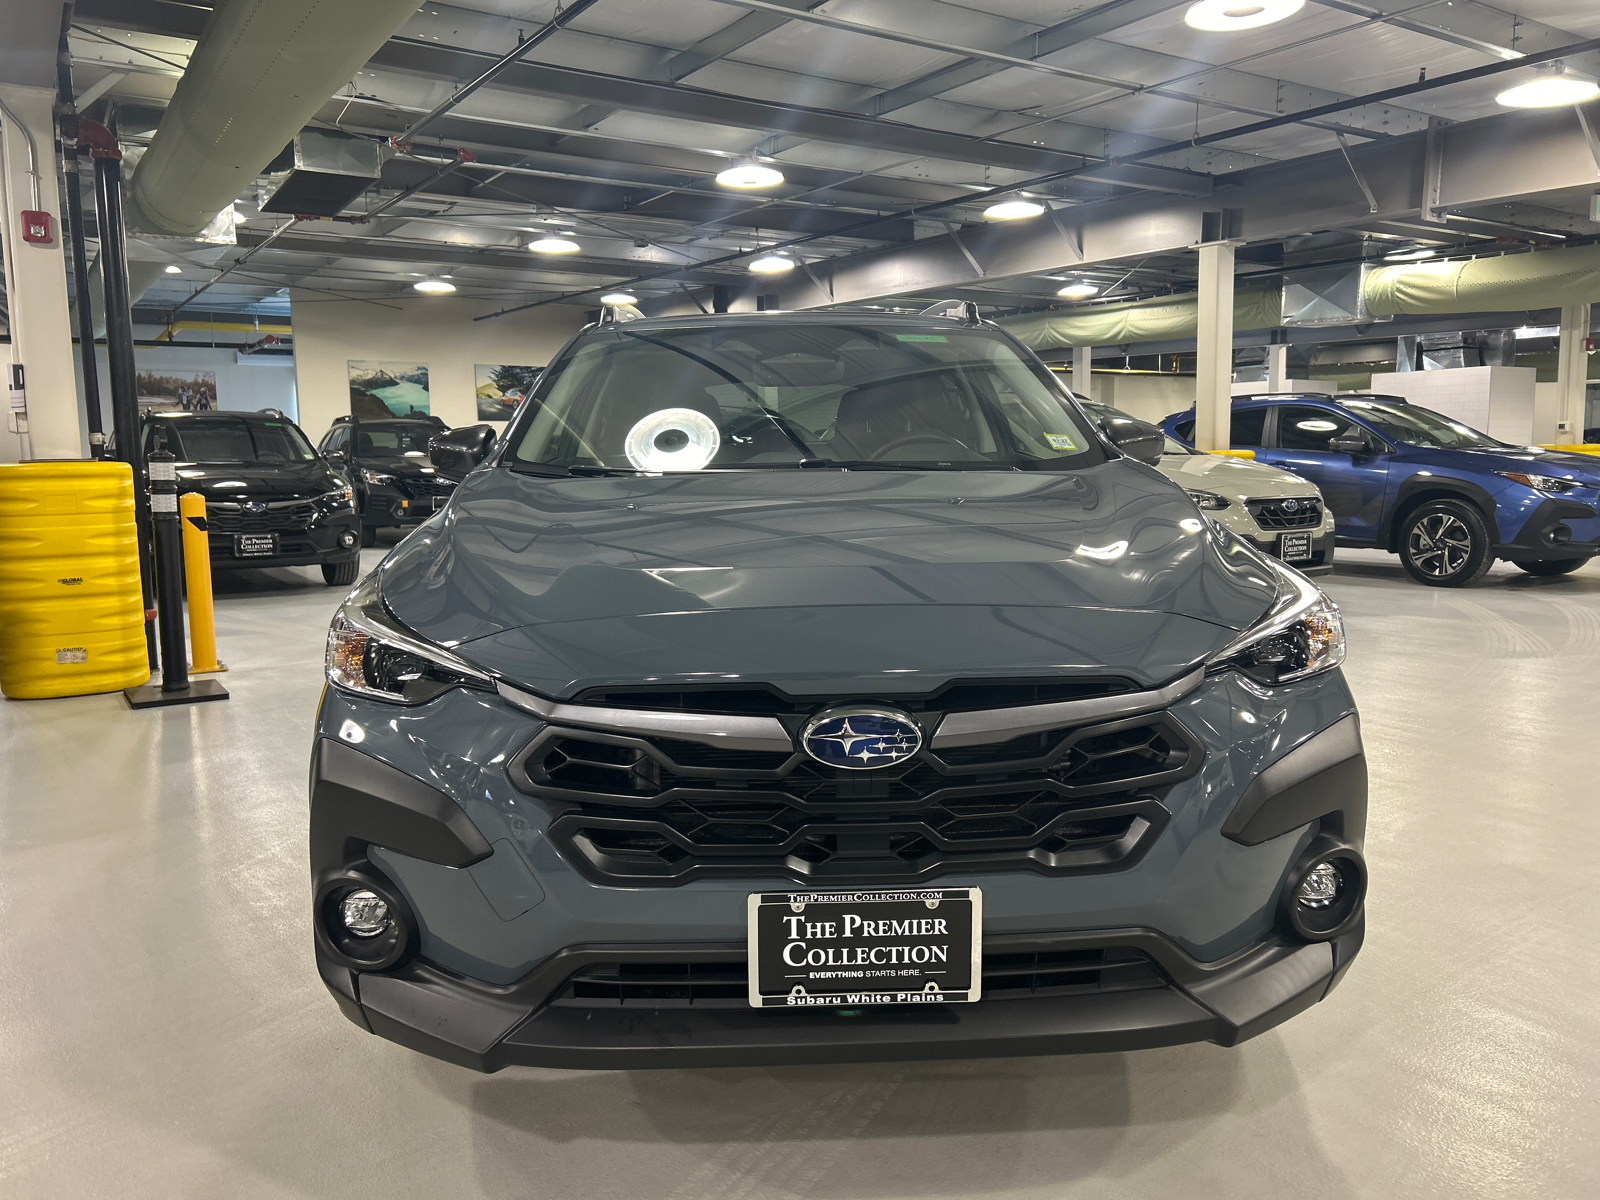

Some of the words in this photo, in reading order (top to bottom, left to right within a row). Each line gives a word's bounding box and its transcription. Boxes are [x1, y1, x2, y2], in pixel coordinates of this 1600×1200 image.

[782, 915, 837, 940] THE
[842, 914, 949, 938] PREMIER
[782, 941, 949, 967] COLLECTION
[809, 970, 864, 979] EVERYTHING
[865, 969, 897, 978] STARTS
[897, 969, 922, 977] HERE.
[786, 995, 841, 1006] Subaru
[846, 993, 893, 1004] White
[897, 992, 944, 1002] Plains
